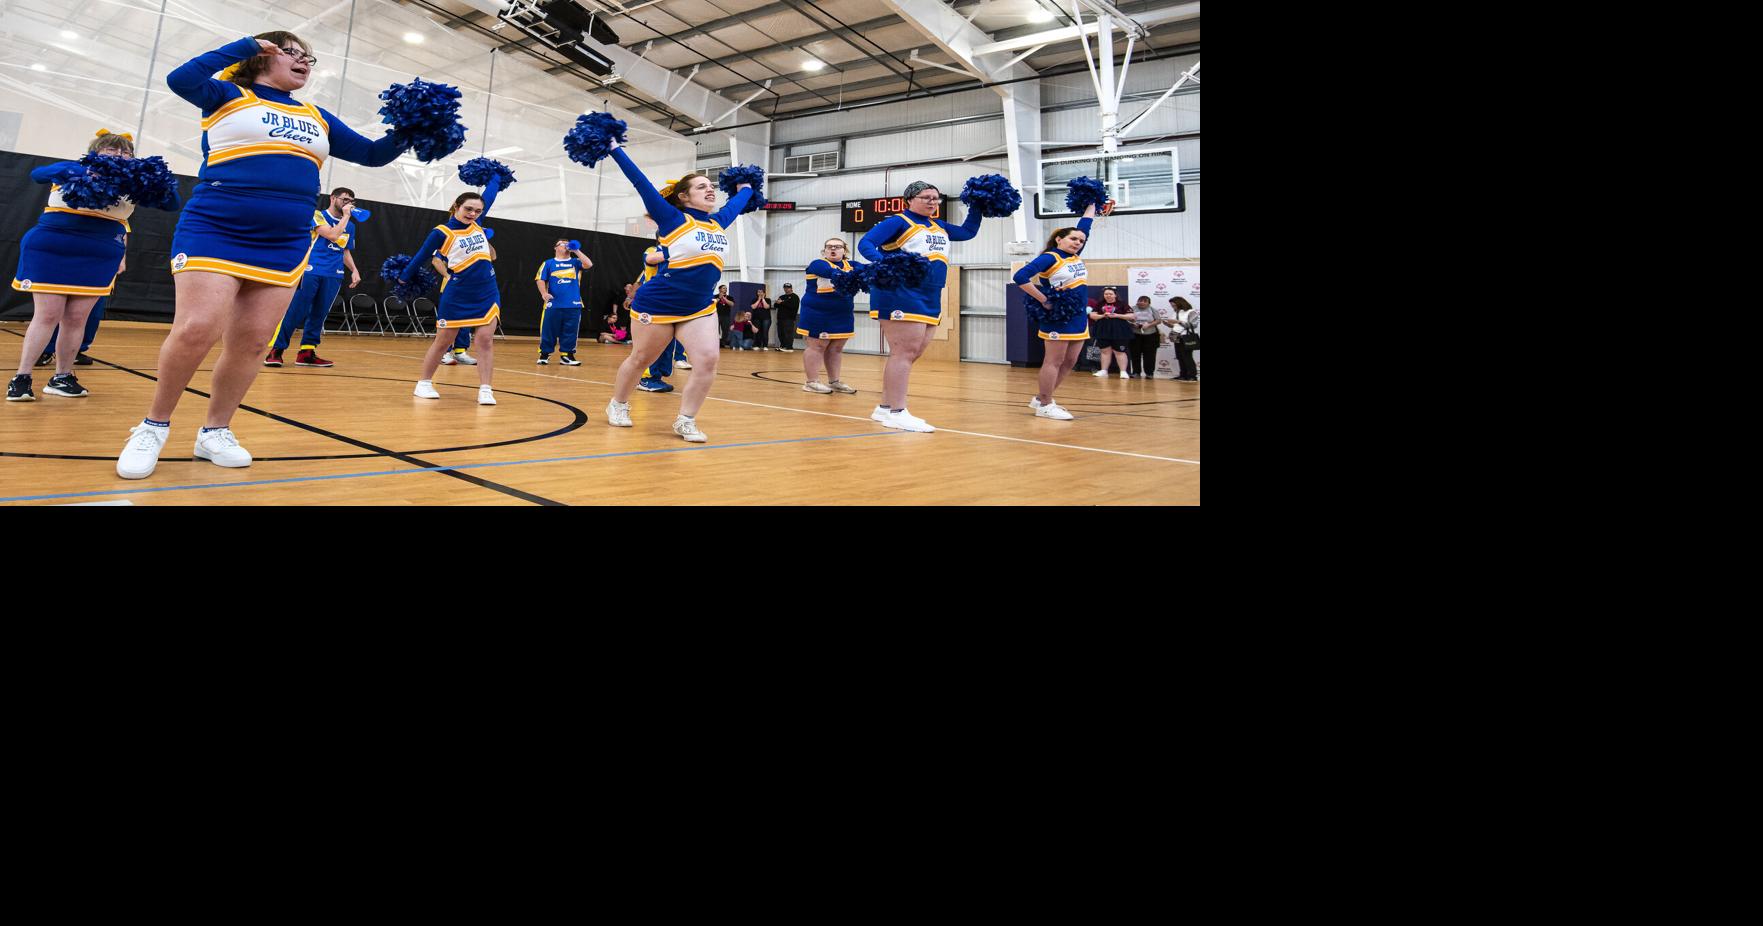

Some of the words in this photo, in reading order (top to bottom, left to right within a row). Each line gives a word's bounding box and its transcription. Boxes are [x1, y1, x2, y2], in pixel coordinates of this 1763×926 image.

[262, 112, 279, 126] JR
[282, 116, 320, 137] BLUES
[269, 127, 312, 144] Cheer
[855, 209, 863, 222] 0
[466, 234, 485, 246] BLUES
[695, 231, 706, 242] JR
[707, 233, 728, 245] BLUES
[466, 245, 483, 254] Cheer
[701, 243, 724, 252] Cheer
